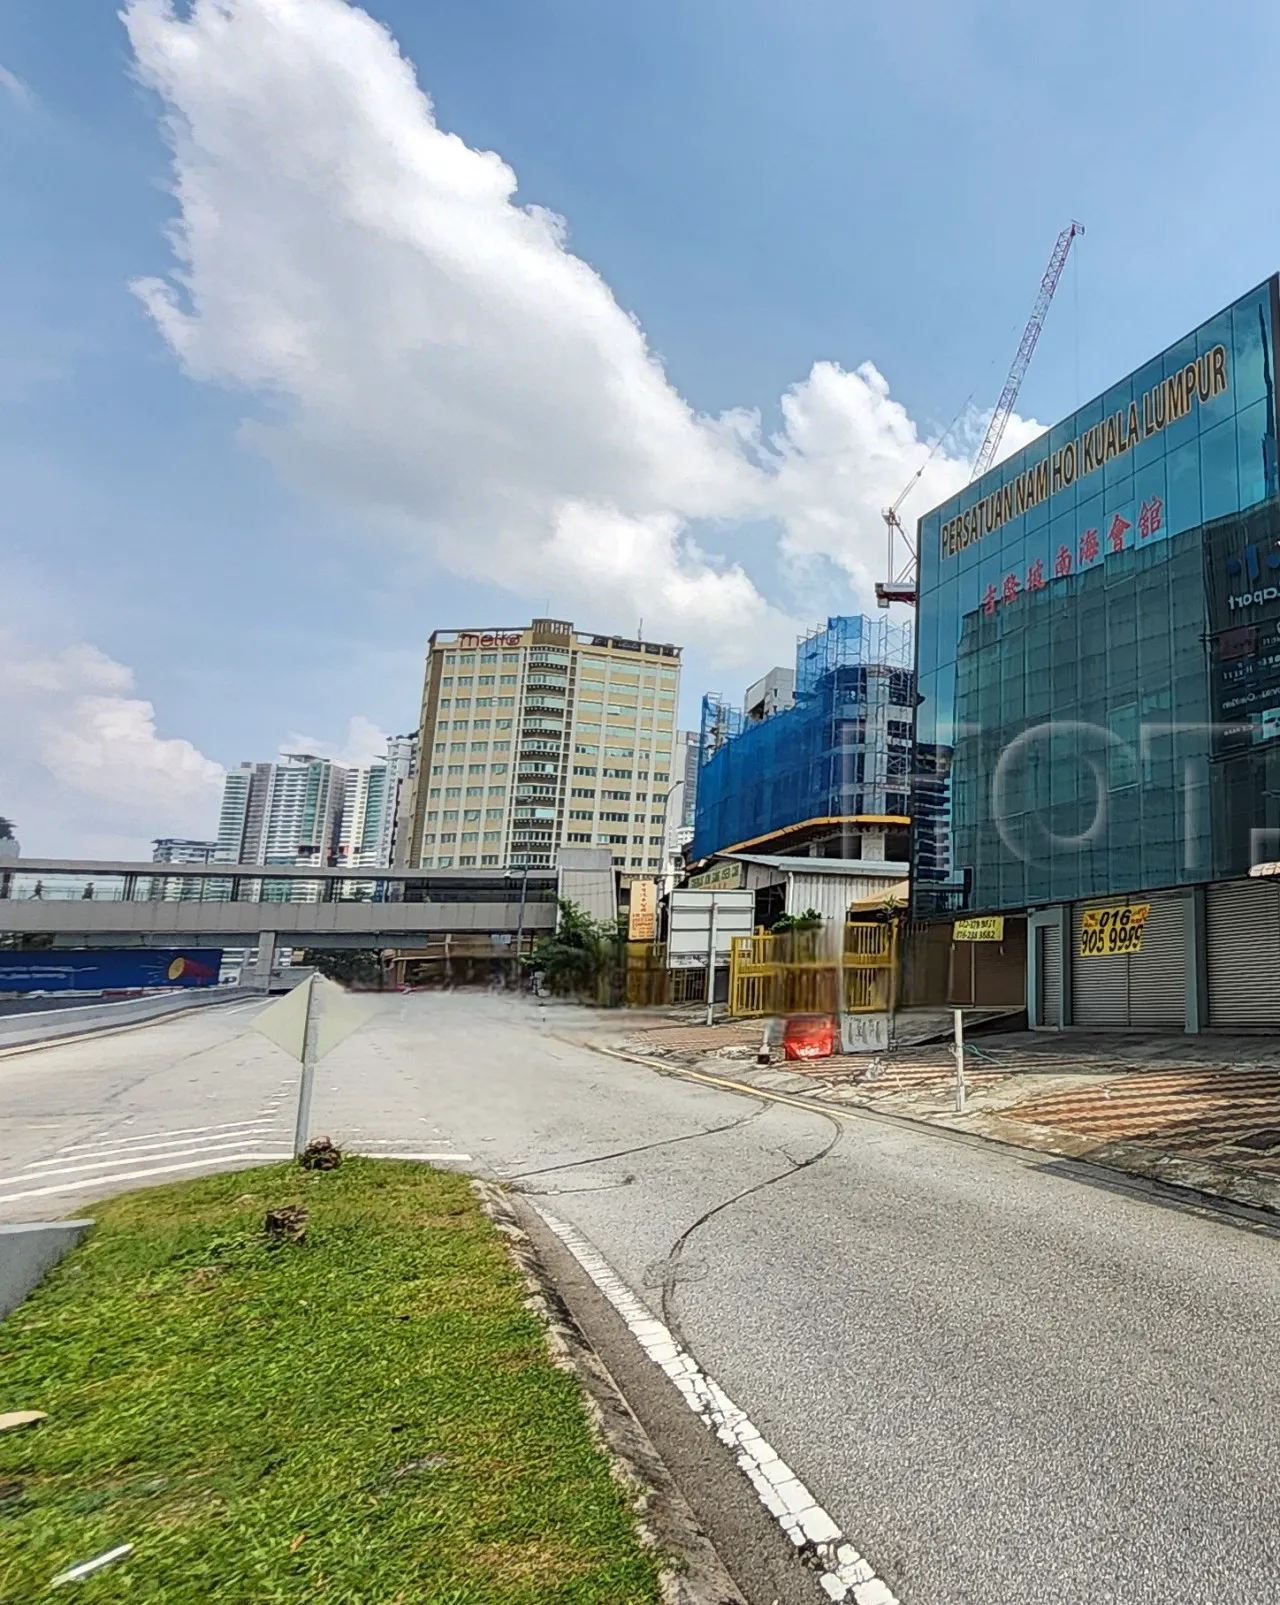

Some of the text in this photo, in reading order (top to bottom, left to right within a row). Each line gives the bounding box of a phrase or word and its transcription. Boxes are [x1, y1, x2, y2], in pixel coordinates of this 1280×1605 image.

[940, 344, 1228, 563] PERSATUAN NAM HOI KUALA LUMPUR
[1099, 909, 1132, 928] 016
[1081, 924, 1144, 953] 905 9999
